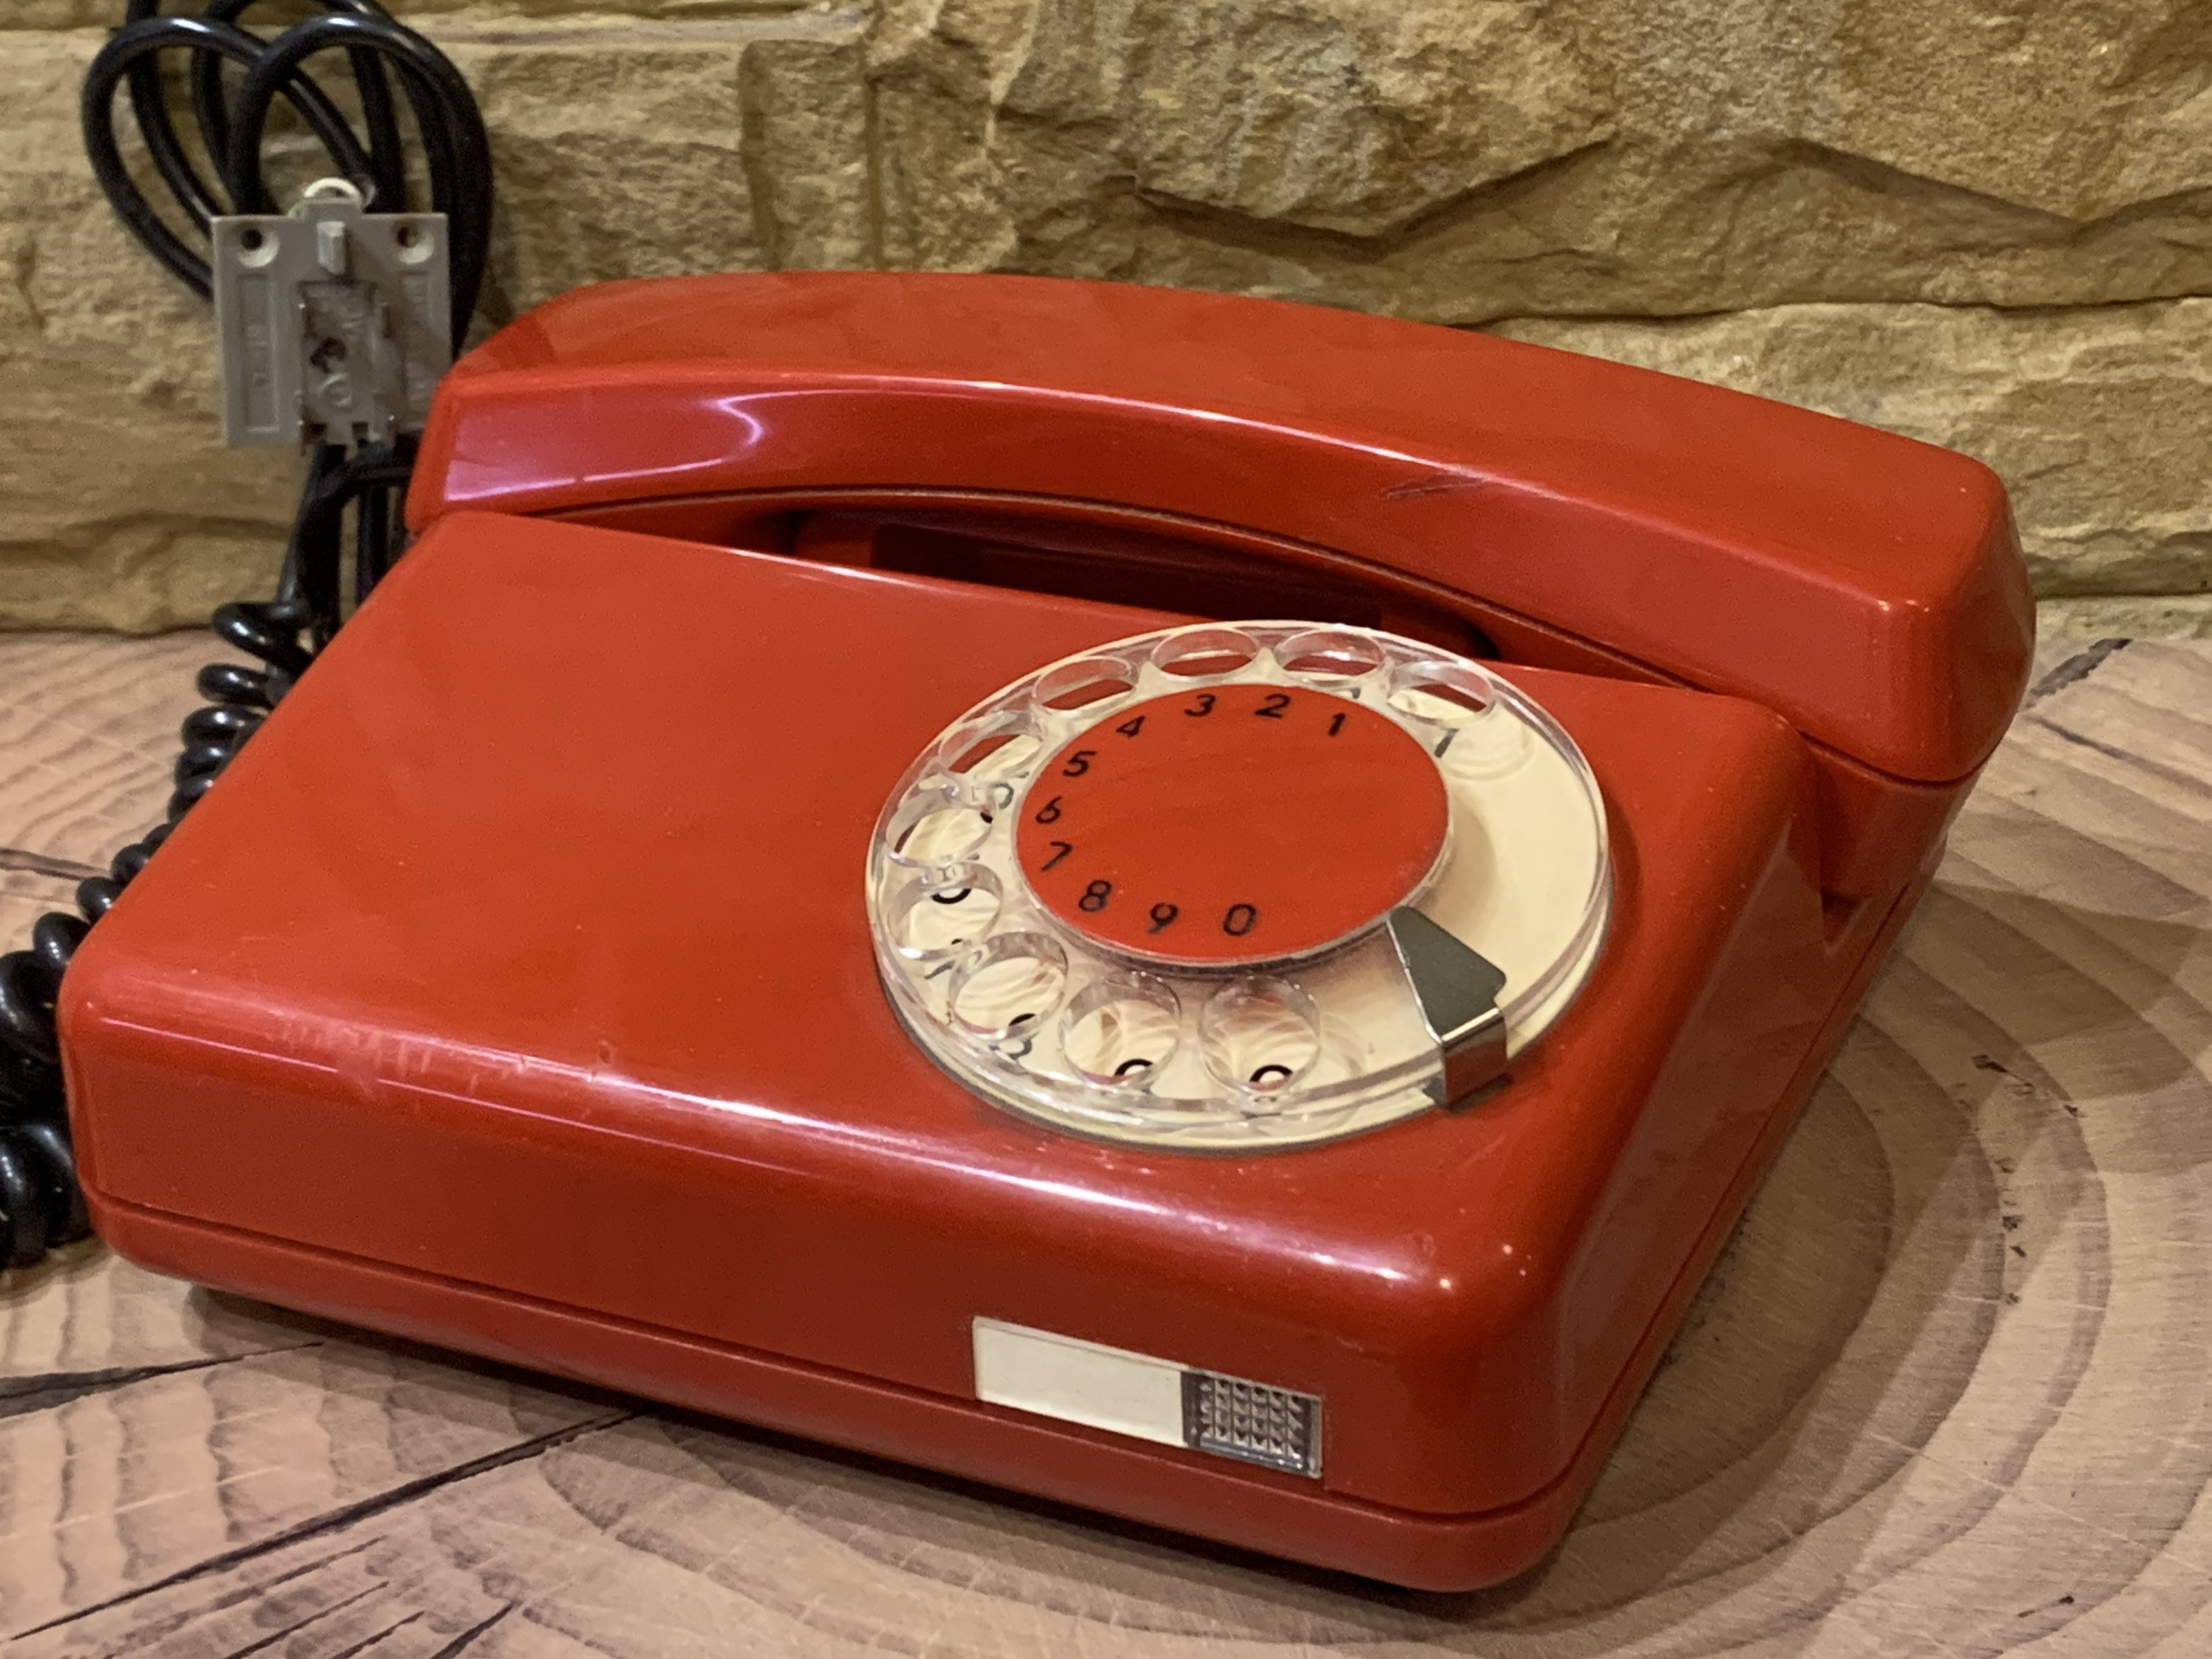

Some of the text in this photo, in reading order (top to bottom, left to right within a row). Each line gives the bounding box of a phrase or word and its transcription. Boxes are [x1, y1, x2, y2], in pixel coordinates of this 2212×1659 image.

[1184, 693, 1217, 718] 3
[1253, 693, 1292, 719] 2
[1116, 714, 1146, 739] 4
[1328, 712, 1346, 737] 1
[1062, 750, 1097, 778] 5
[1035, 795, 1062, 825] 6
[1040, 841, 1073, 872] 7
[1077, 878, 1113, 913] 8
[1147, 902, 1179, 934] 9
